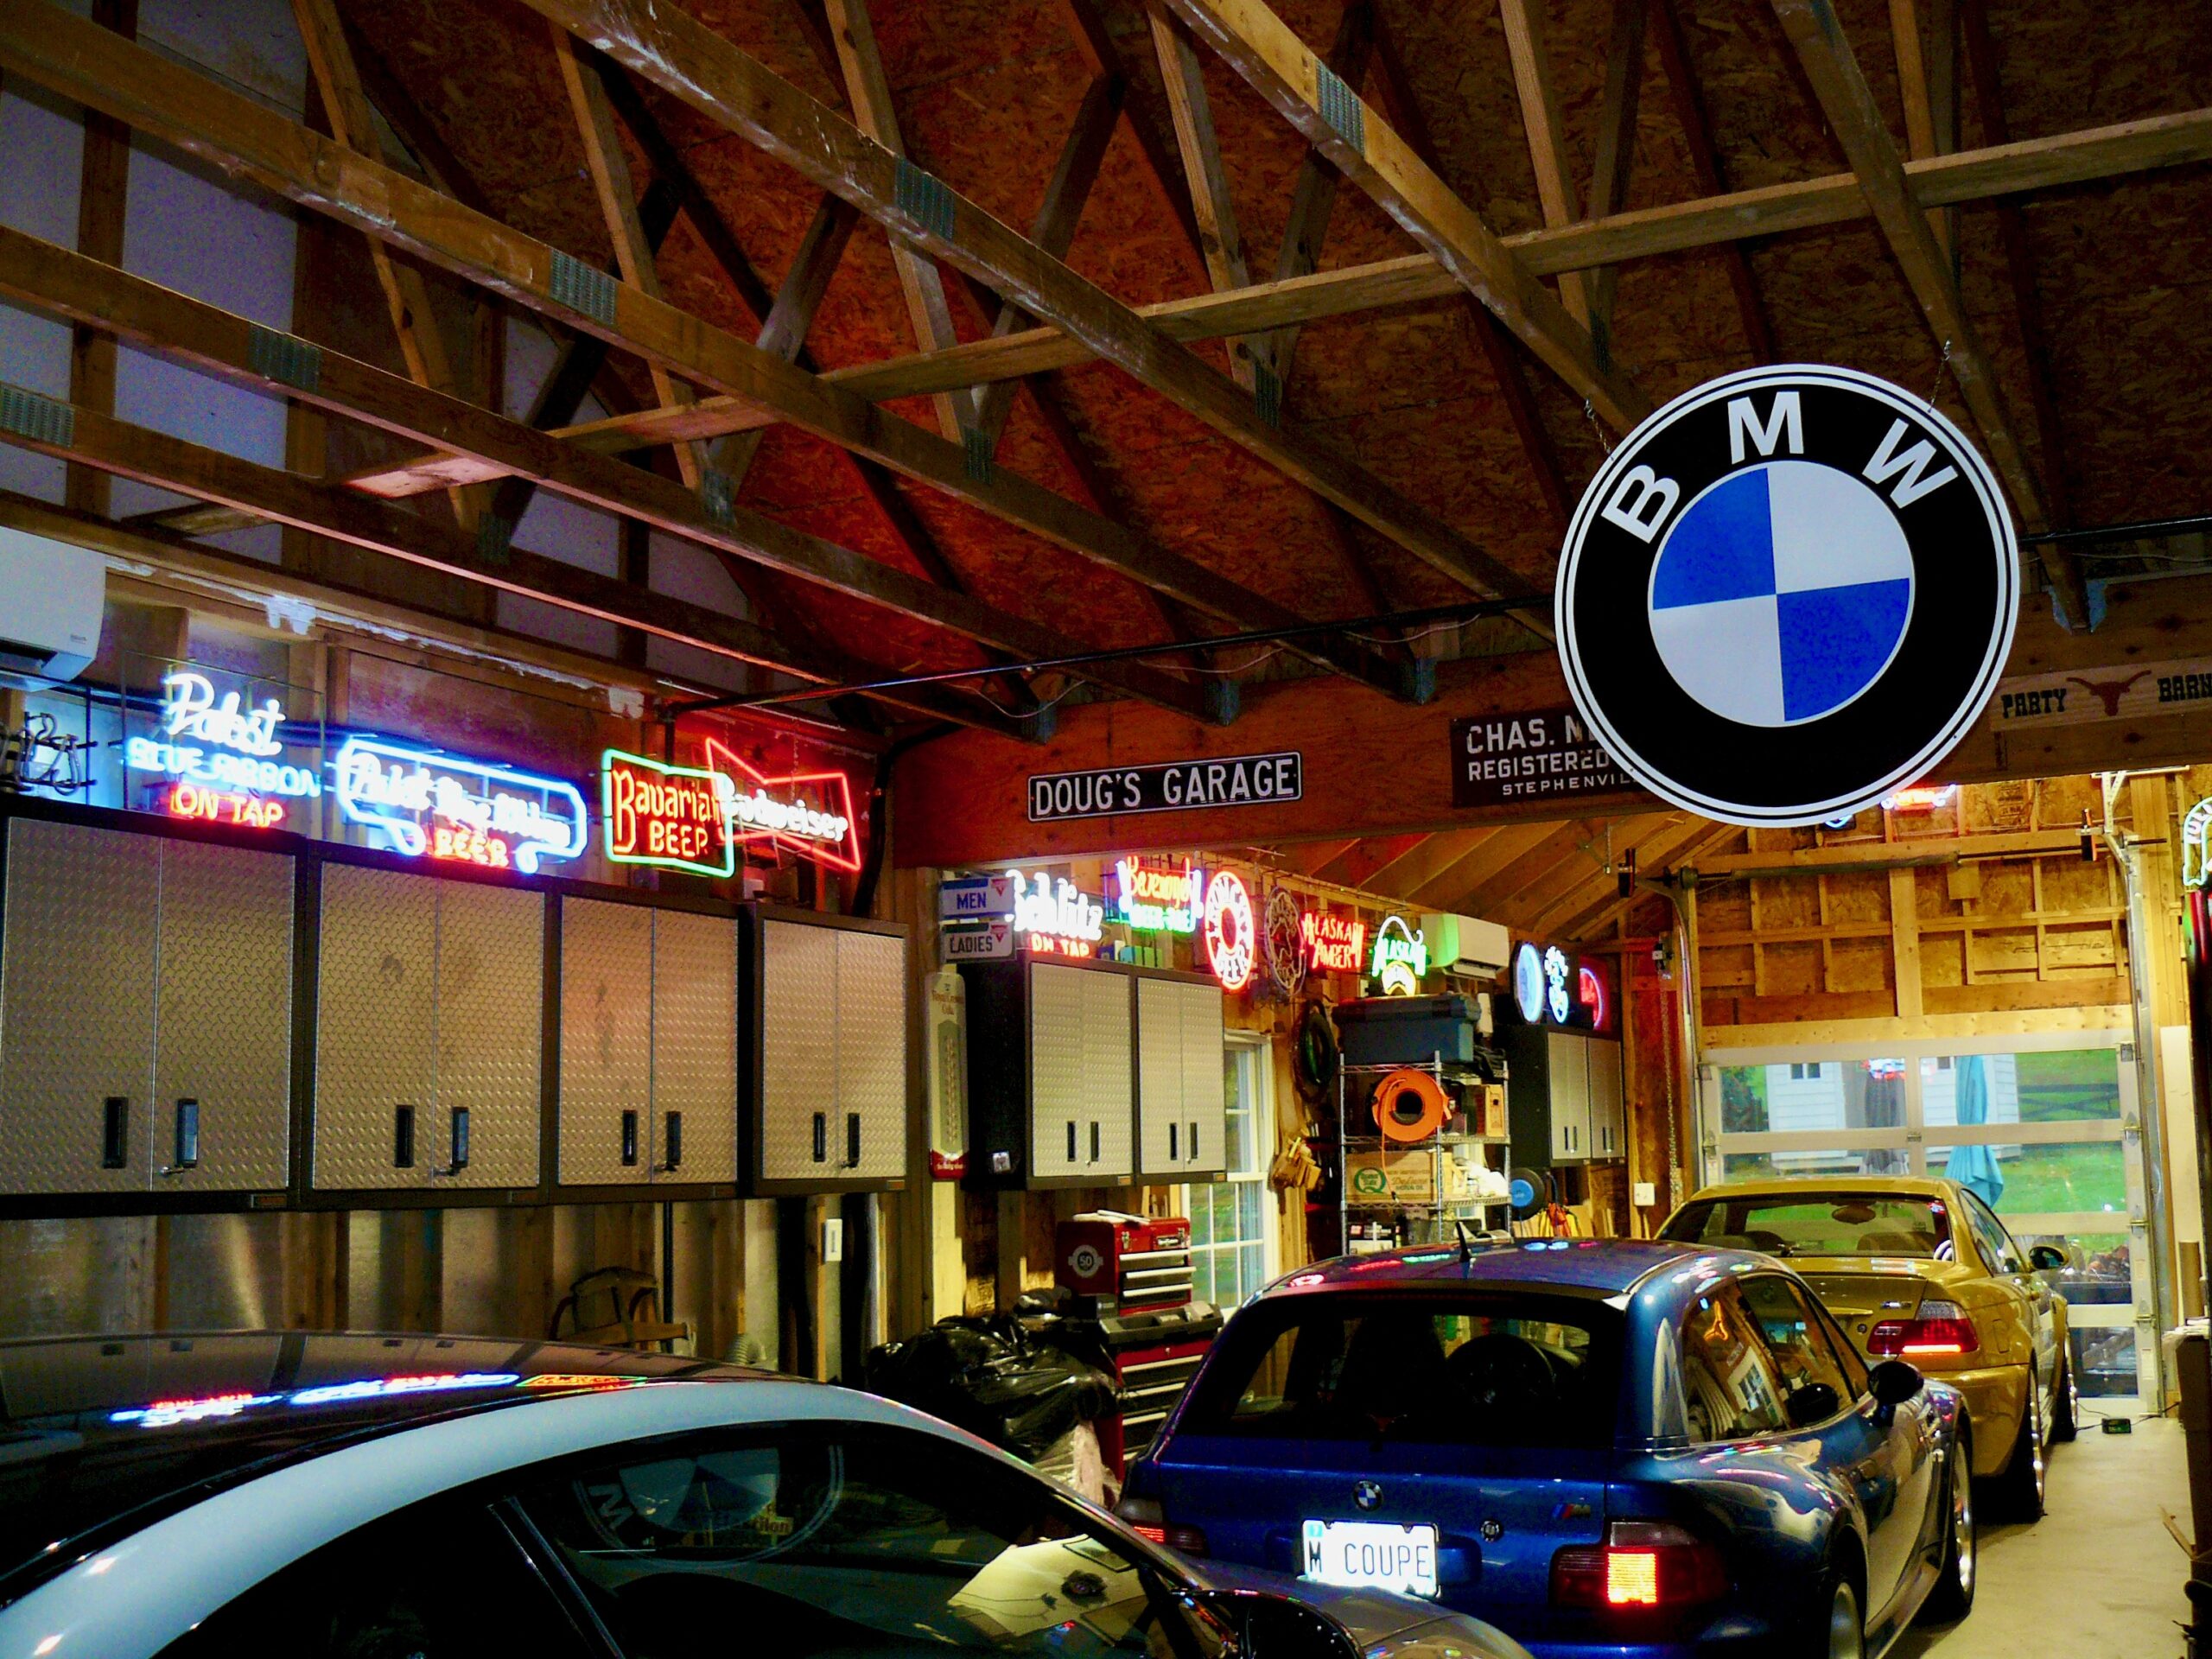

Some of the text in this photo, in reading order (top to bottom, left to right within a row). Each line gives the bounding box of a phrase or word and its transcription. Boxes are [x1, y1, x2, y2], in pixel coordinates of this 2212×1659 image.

[1601, 391, 1959, 543] BMW
[162, 672, 285, 756] Pabst
[2001, 672, 2212, 719] PARTY BARN
[1466, 718, 1554, 753] CHAS.
[1468, 748, 1610, 782] REGISTERED
[1502, 773, 1639, 796] STEPHENVIL
[174, 785, 284, 828] ON TAP
[717, 772, 849, 842] Budweiser
[1035, 758, 1295, 817] DOUG'S GARAGE
[434, 828, 509, 868] BEER
[648, 818, 709, 857] BEER
[957, 893, 987, 910] MEN
[950, 935, 993, 954] LADIES
[1031, 932, 1090, 957] ON TAP
[1301, 912, 1364, 969] ALASKAN
[1312, 938, 1352, 969] AMBER
[1344, 1542, 1431, 1579] COUPE
